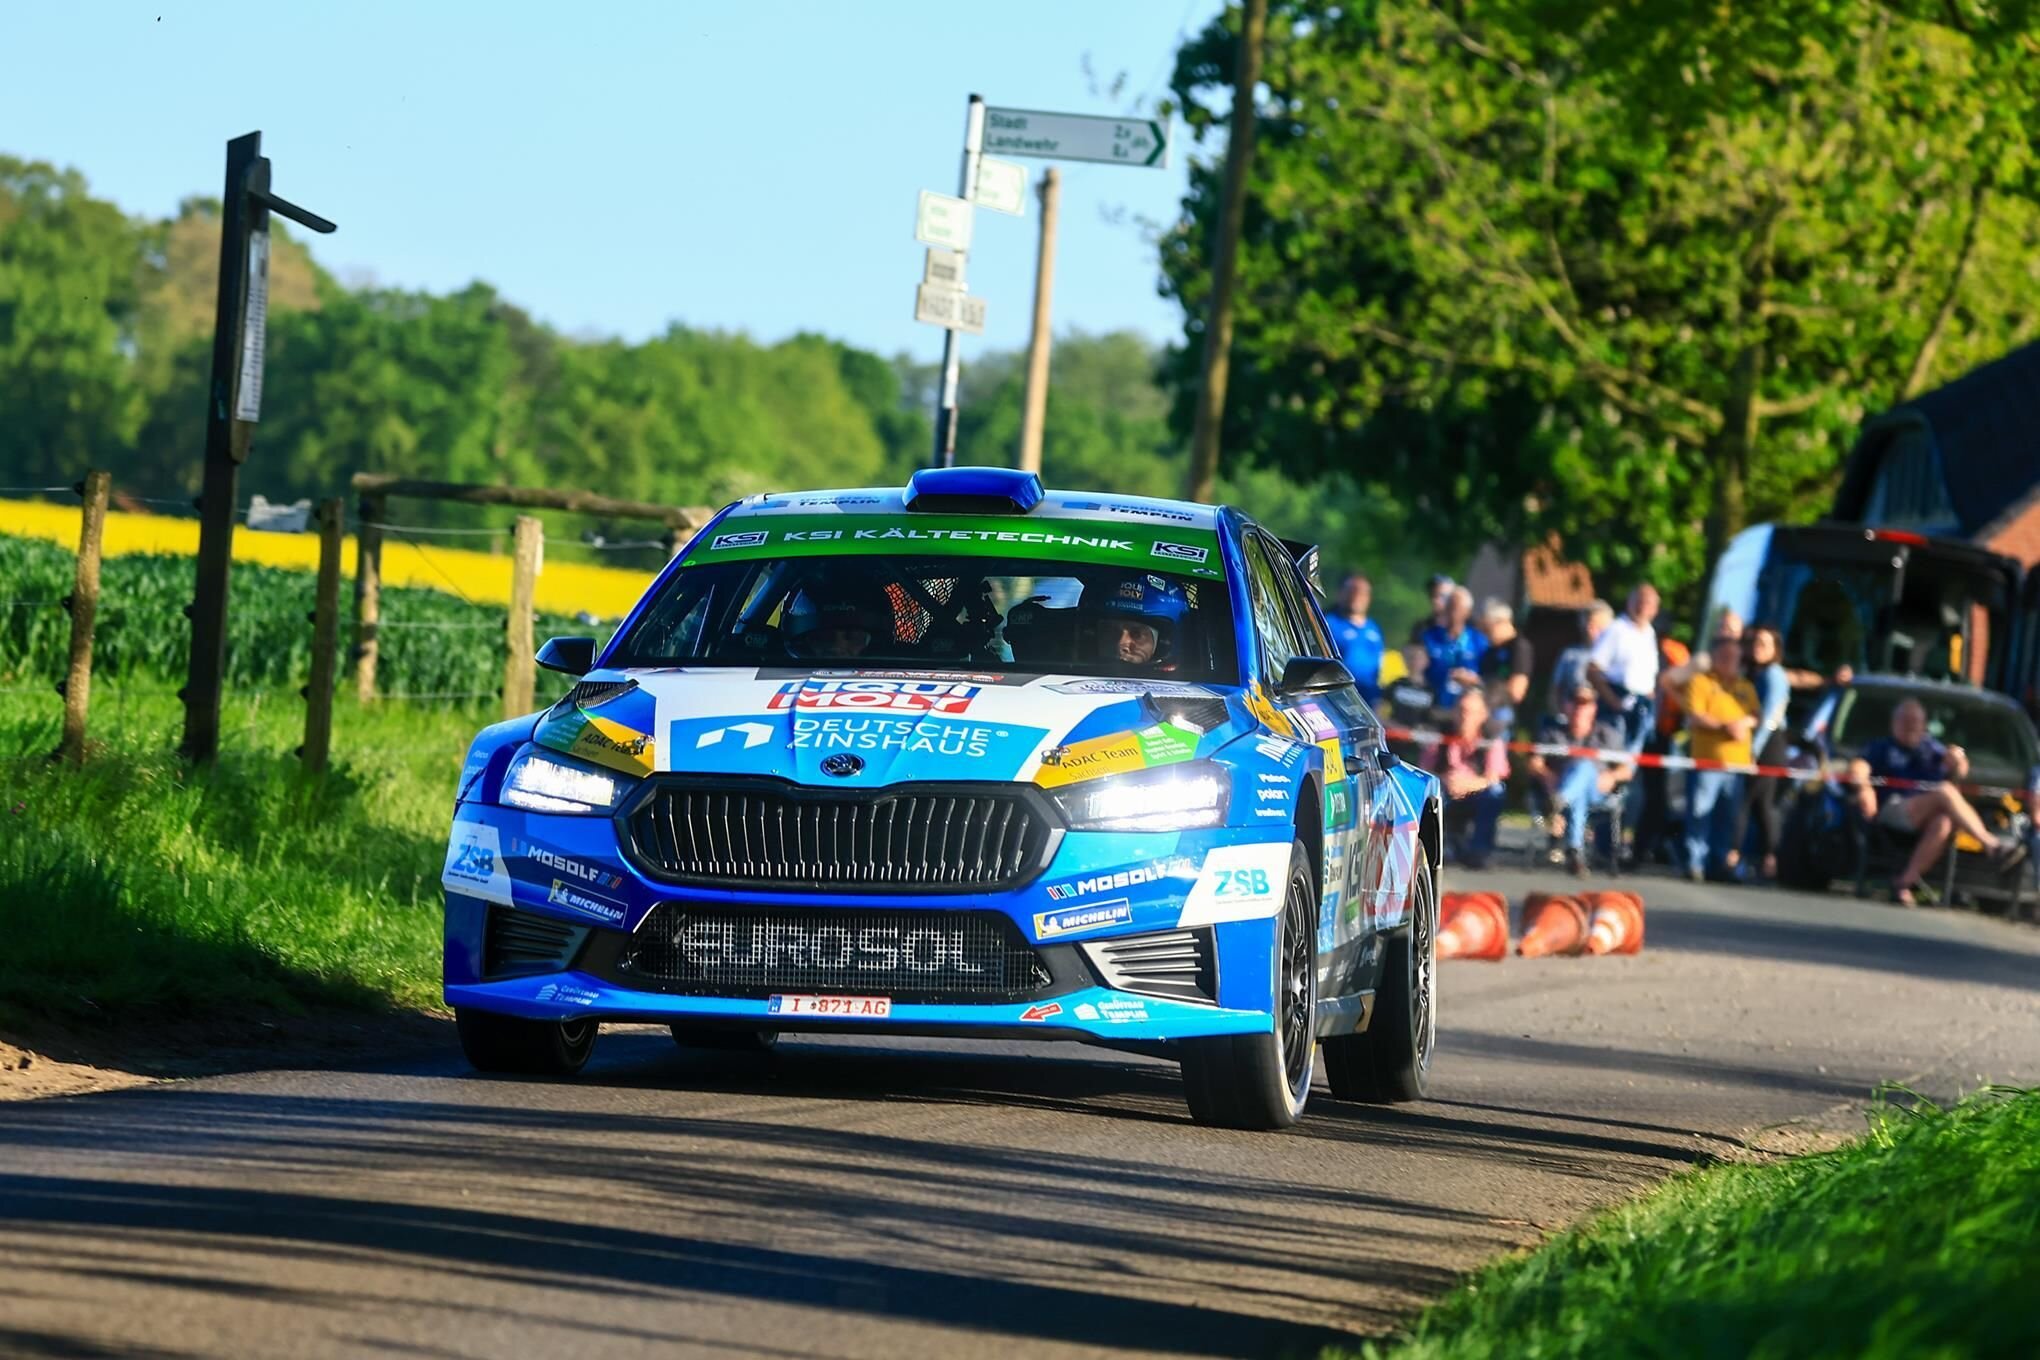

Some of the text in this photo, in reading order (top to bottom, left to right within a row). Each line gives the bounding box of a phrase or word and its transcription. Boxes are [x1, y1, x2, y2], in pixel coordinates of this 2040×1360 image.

[990, 114, 1028, 129] Stadt
[986, 134, 1059, 151] Landwehr
[1109, 507, 1193, 522] TEMPLIN
[784, 528, 1134, 551] KSI KÄLTETECHNIK
[786, 680, 976, 697] LIQUI
[775, 691, 968, 713] MOLY
[791, 732, 987, 757] ZINSHAUS
[1062, 746, 1139, 769] ADAC Team
[452, 844, 494, 877] ZSB
[528, 845, 600, 881] MOSOLF
[1077, 863, 1167, 896] MOSOLF
[1214, 868, 1271, 897] ZSB
[569, 893, 625, 921] MICHELIN
[1061, 906, 1129, 929] MICHELIN
[818, 1000, 852, 1014] 871
[861, 1001, 887, 1015] AG
